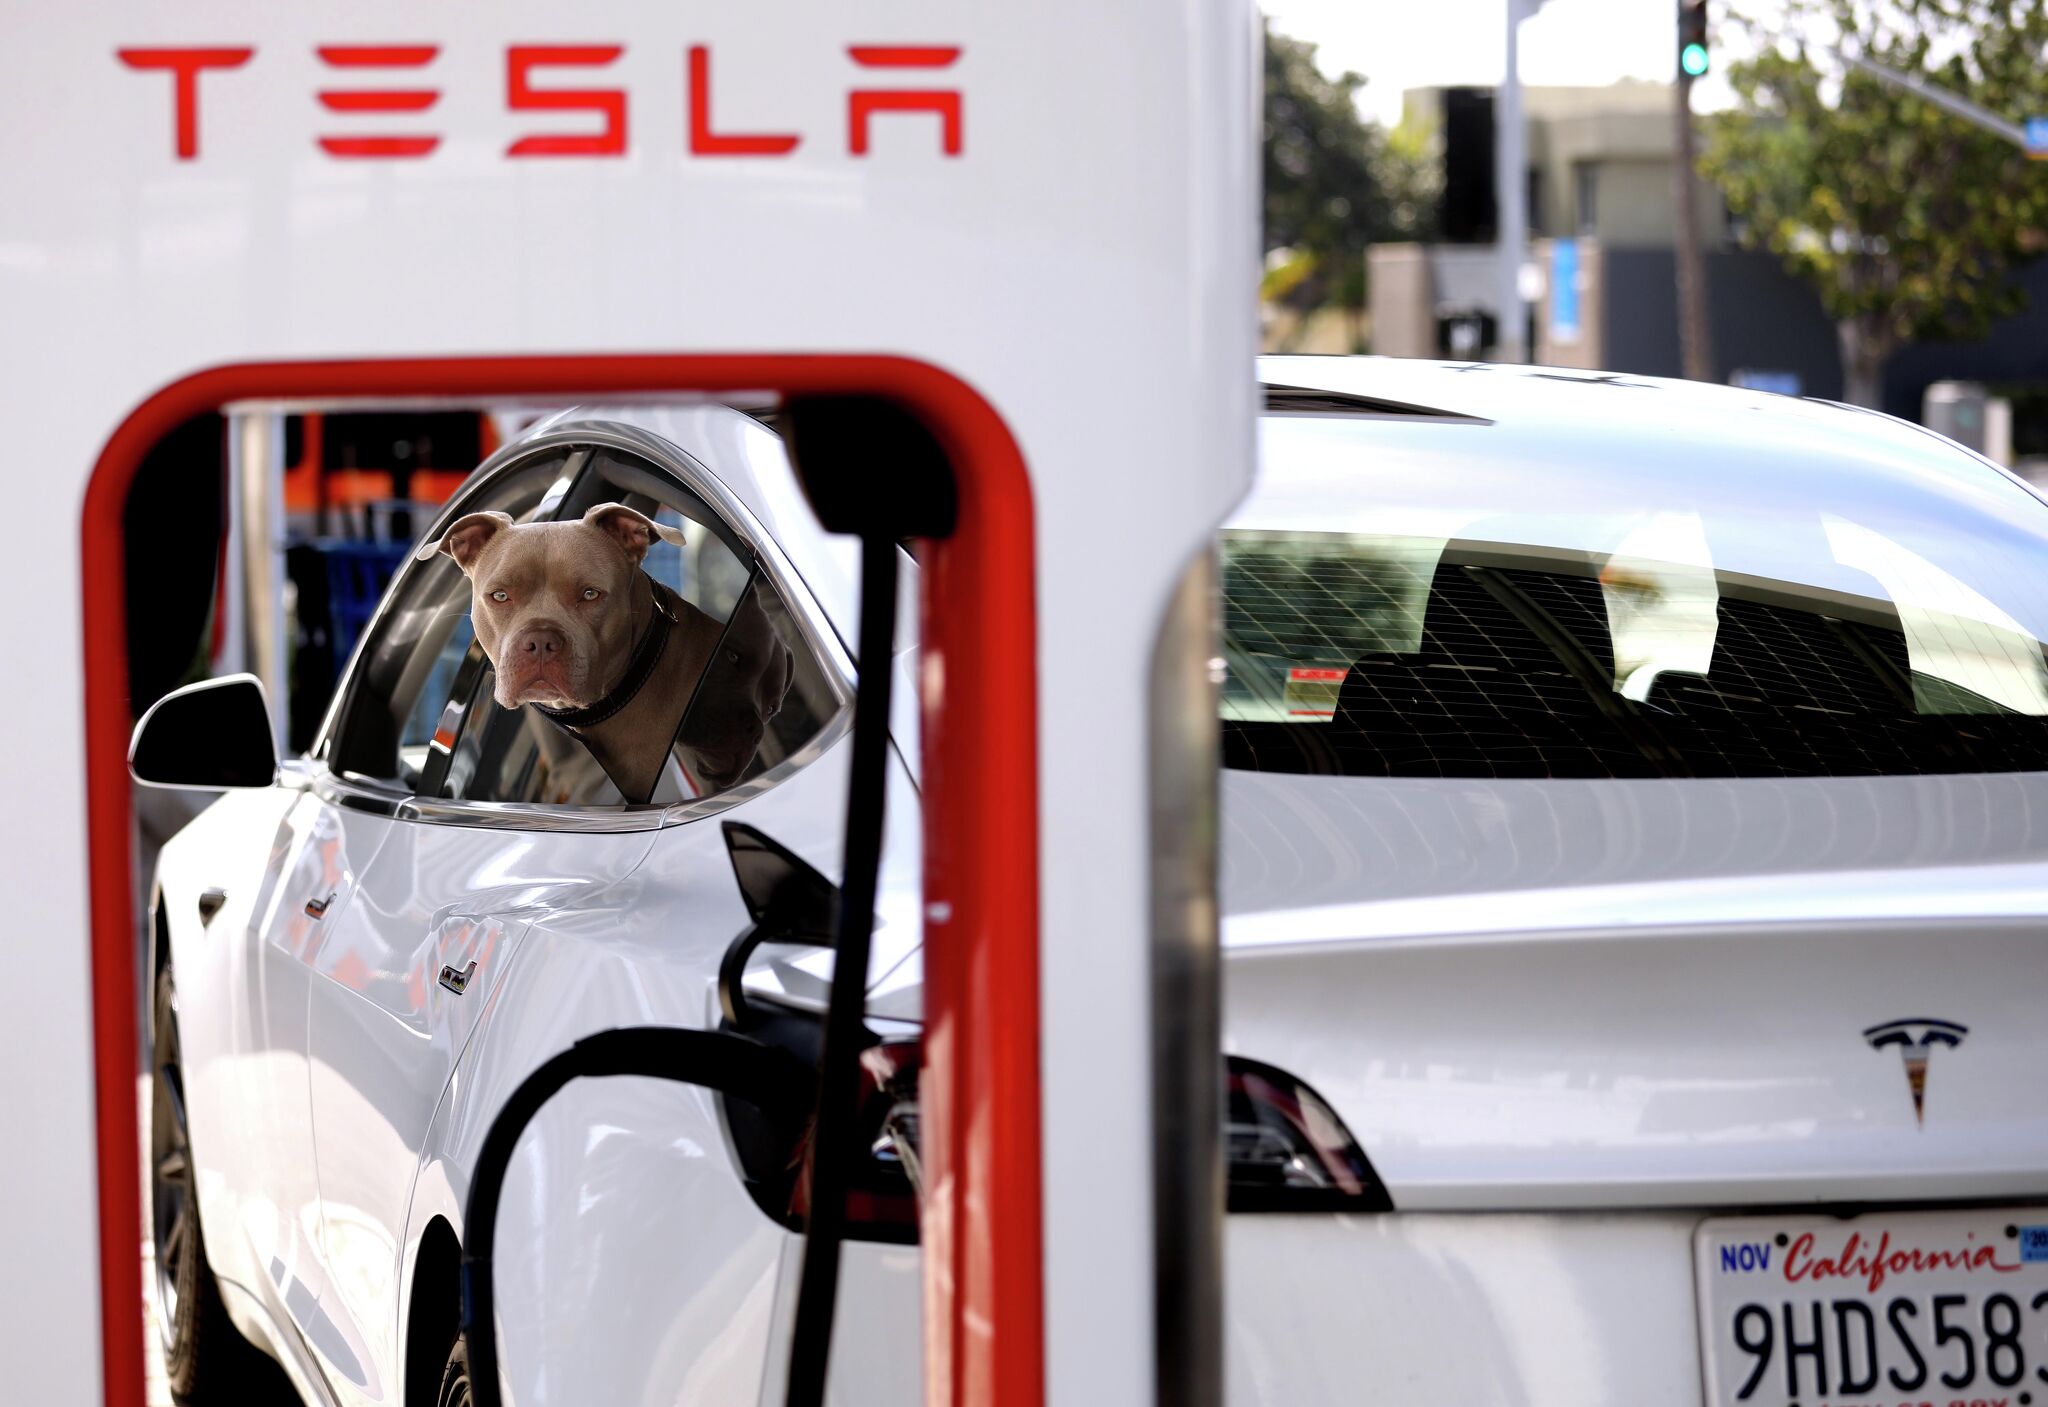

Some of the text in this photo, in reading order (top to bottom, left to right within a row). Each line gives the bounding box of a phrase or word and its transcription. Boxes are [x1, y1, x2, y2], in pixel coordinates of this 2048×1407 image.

[116, 44, 964, 161] TESLA
[1720, 1243, 1771, 1273] NOV
[1782, 1231, 2022, 1294] California
